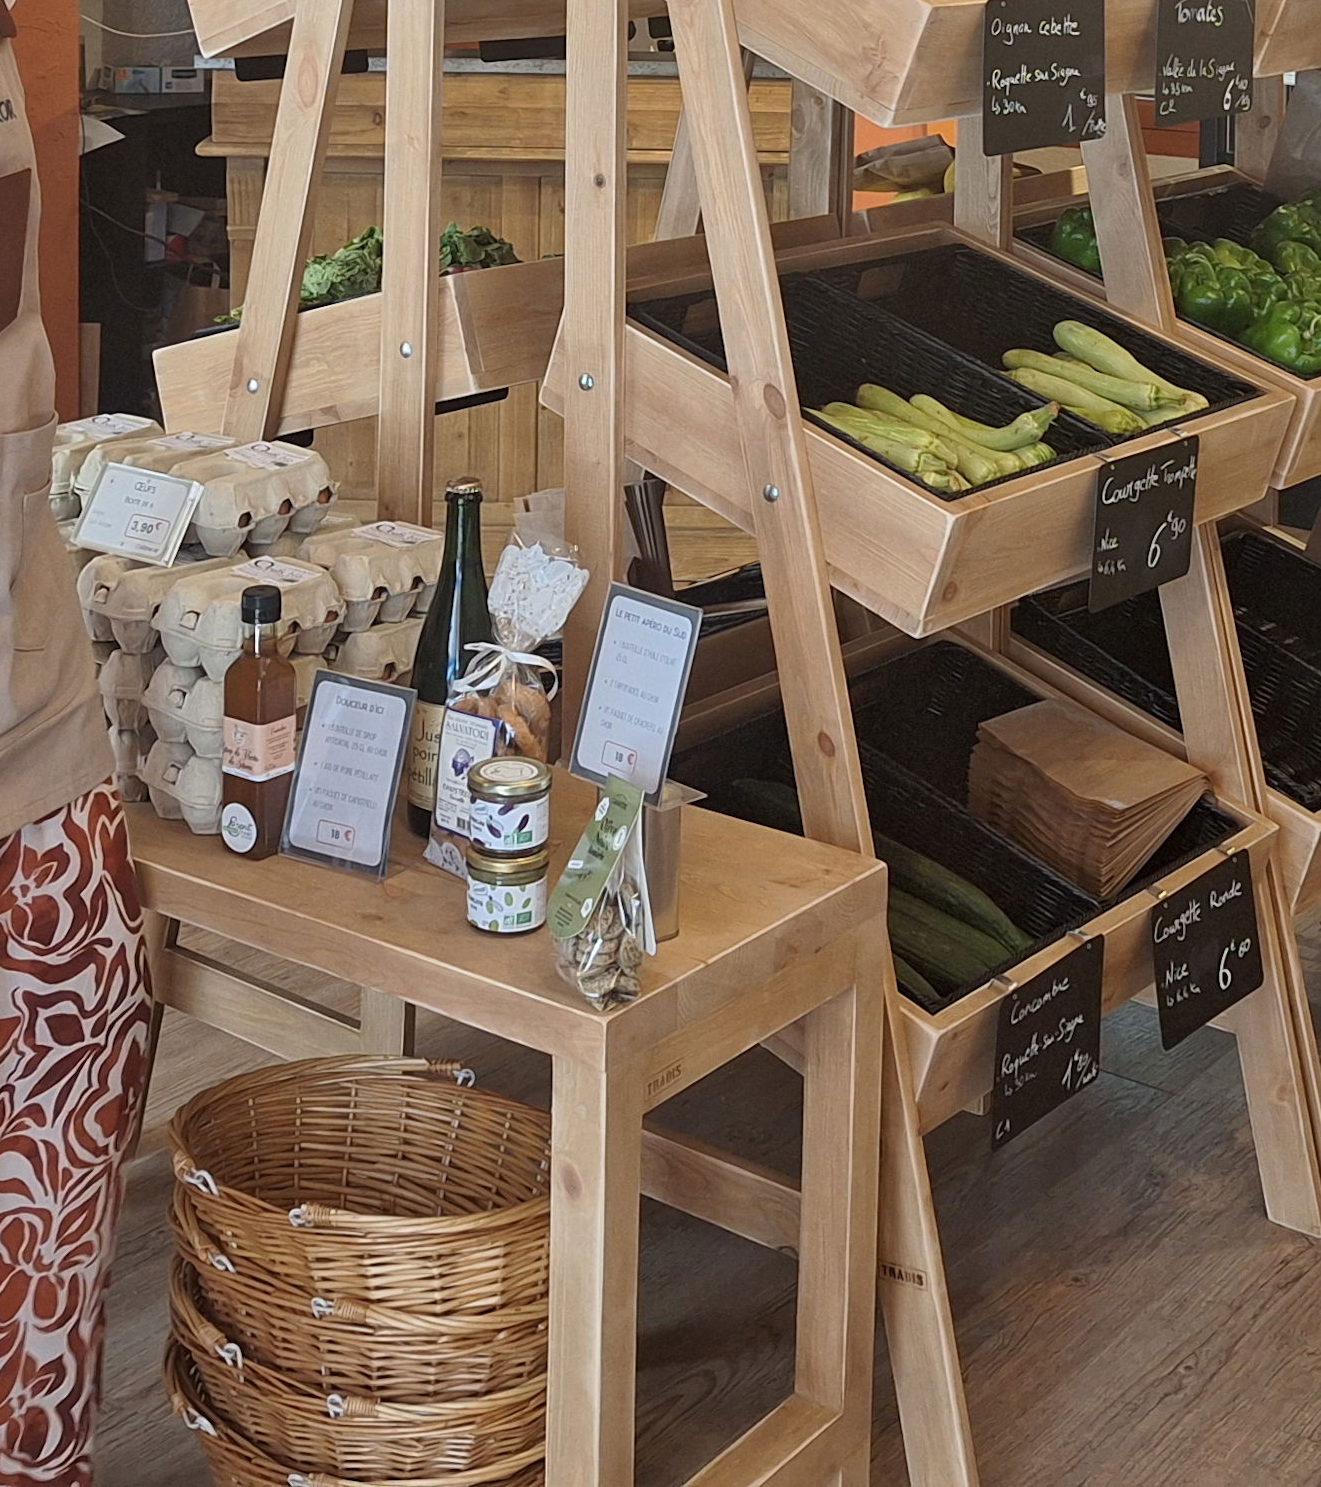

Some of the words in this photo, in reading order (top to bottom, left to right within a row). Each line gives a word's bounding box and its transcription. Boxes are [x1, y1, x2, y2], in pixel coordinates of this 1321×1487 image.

[991, 17, 1033, 46] Oignon
[1101, 464, 1160, 505] Courgette
[1101, 527, 1120, 551] Nice
[1154, 898, 1202, 944] Courgette
[1209, 879, 1243, 909] Ronde
[1164, 961, 1190, 990] Nice
